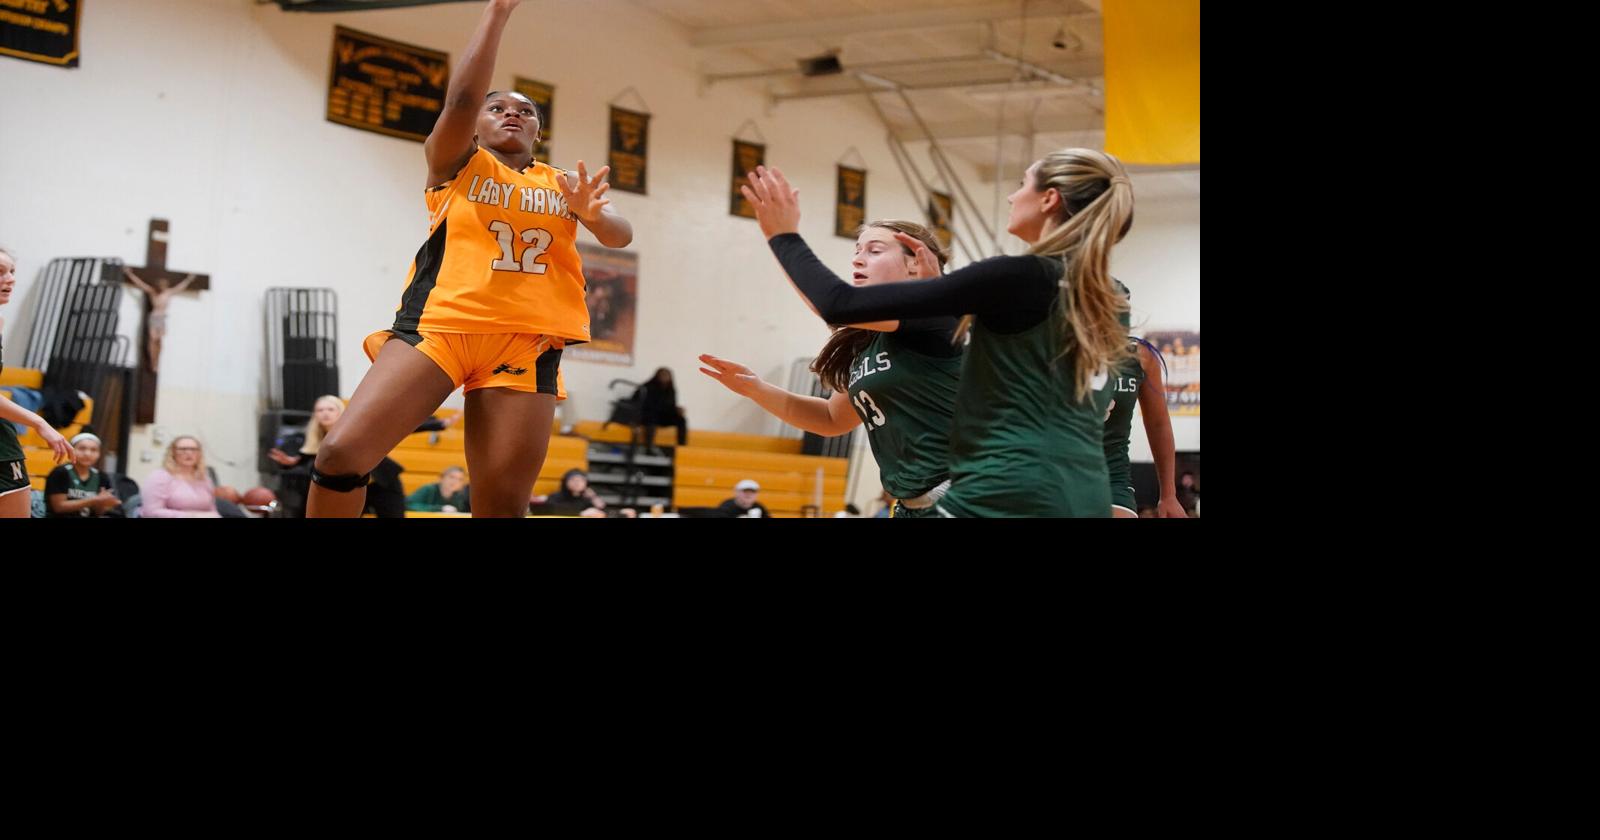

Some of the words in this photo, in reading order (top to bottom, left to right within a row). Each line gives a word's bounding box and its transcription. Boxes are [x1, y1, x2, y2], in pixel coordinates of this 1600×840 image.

[467, 175, 516, 209] LADY
[488, 219, 553, 275] 12
[853, 390, 886, 431] 13
[10, 461, 23, 481] N
